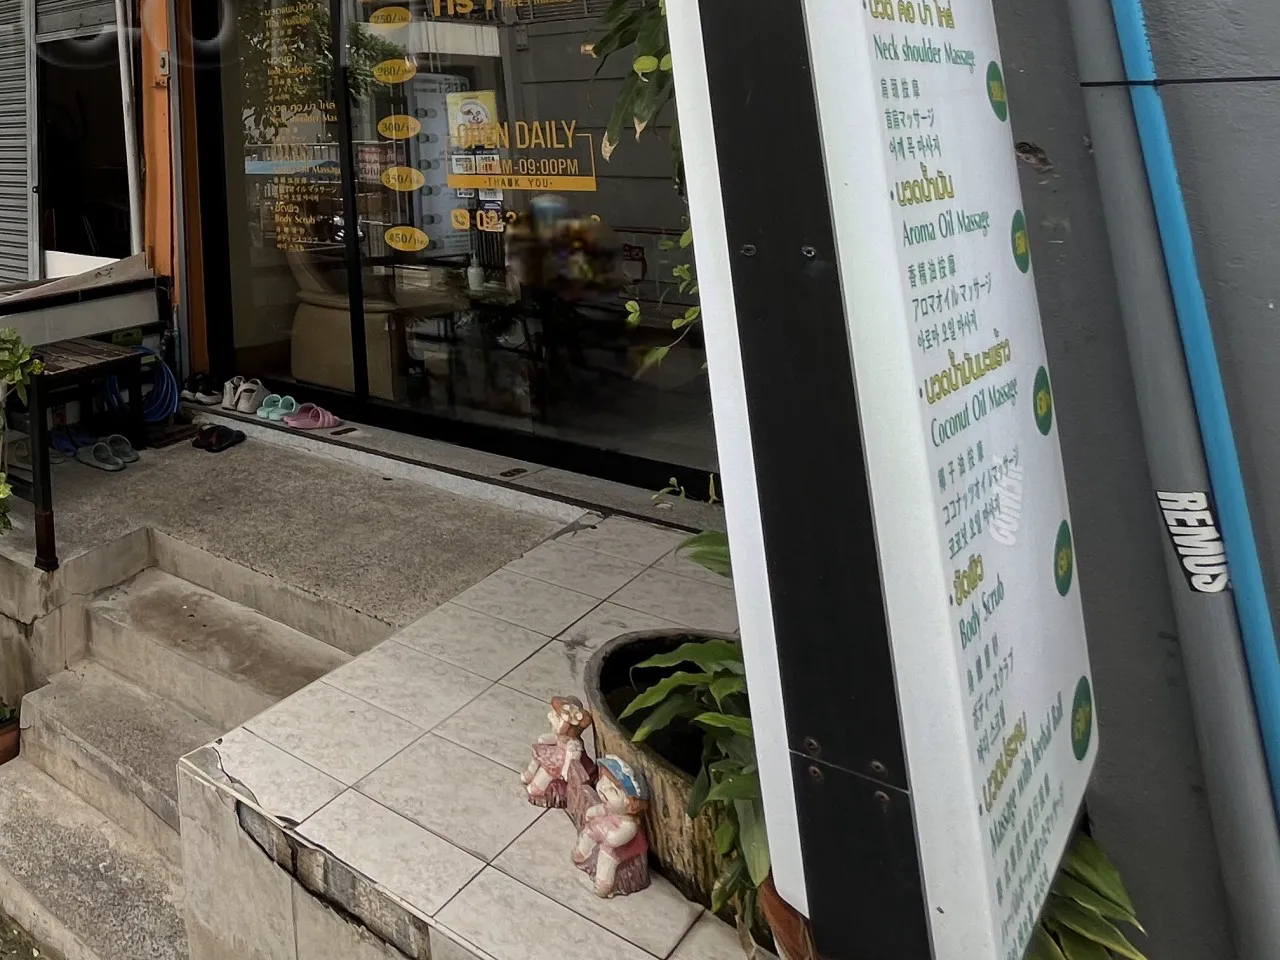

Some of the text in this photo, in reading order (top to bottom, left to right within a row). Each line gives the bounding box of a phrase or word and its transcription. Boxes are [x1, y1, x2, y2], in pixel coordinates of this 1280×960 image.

[898, 0, 915, 24] คอ
[873, 34, 899, 61] Neck
[902, 37, 941, 64] shoulder
[458, 120, 577, 149] OPEN DAILY
[528, 177, 549, 188] YOU
[895, 162, 955, 206] นวดน้ำมัน
[902, 208, 990, 247] Aroma Oil Massage
[931, 406, 970, 447] Coconut
[971, 389, 987, 422] Oil
[1157, 491, 1229, 593] REMUS
[958, 602, 982, 650] Body
[982, 573, 1005, 621] Scrub
